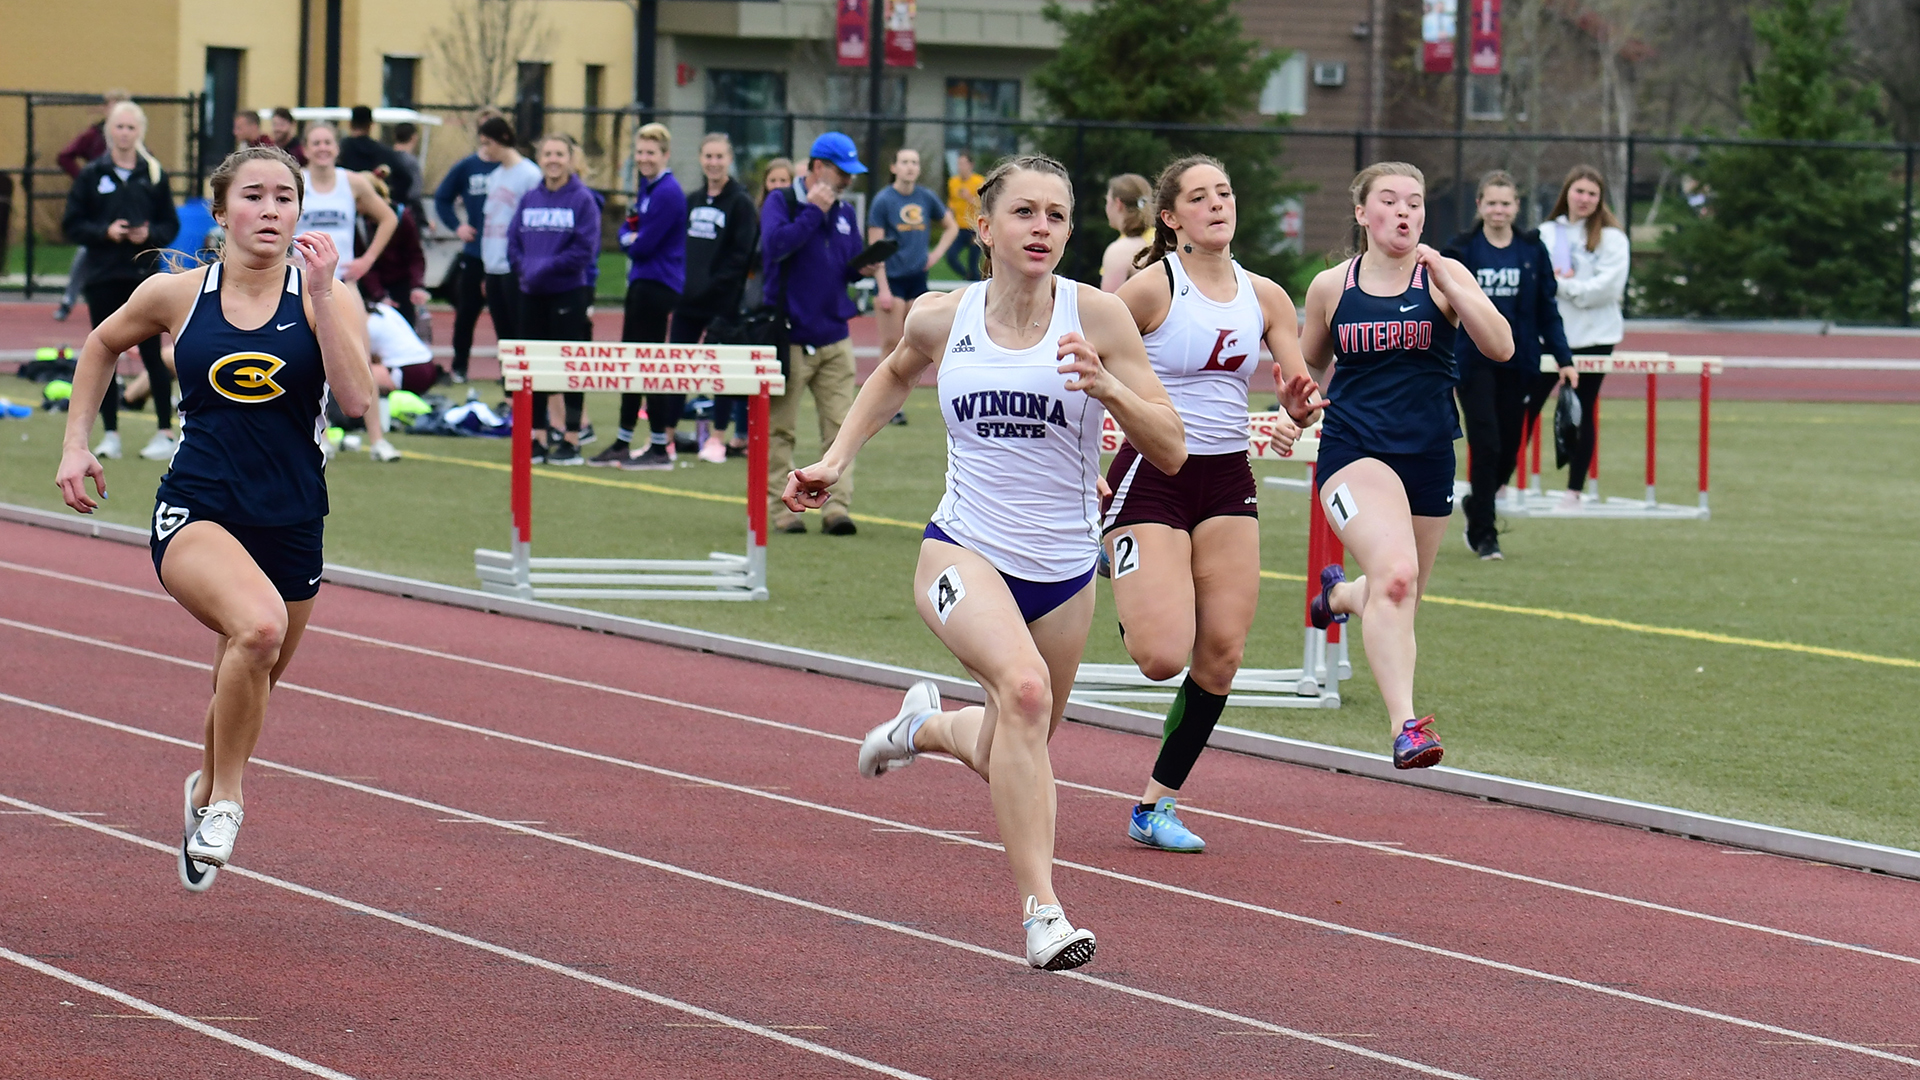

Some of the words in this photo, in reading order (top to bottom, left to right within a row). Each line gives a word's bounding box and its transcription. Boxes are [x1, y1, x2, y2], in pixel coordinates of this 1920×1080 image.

[951, 345, 976, 354] adidas
[1338, 321, 1433, 353] VITERBO
[561, 345, 627, 358] SAINT
[635, 348, 717, 359] MARY'S
[565, 361, 631, 372] SAINT
[639, 363, 722, 374] MARY'S
[568, 376, 634, 389] SAINT
[643, 377, 726, 393] MARY'S
[951, 390, 1069, 428] WINONA
[976, 422, 1047, 438] STATE
[160, 504, 186, 532] 5
[1331, 491, 1349, 521] 1
[1116, 535, 1134, 574] 2
[938, 573, 958, 614] 4
